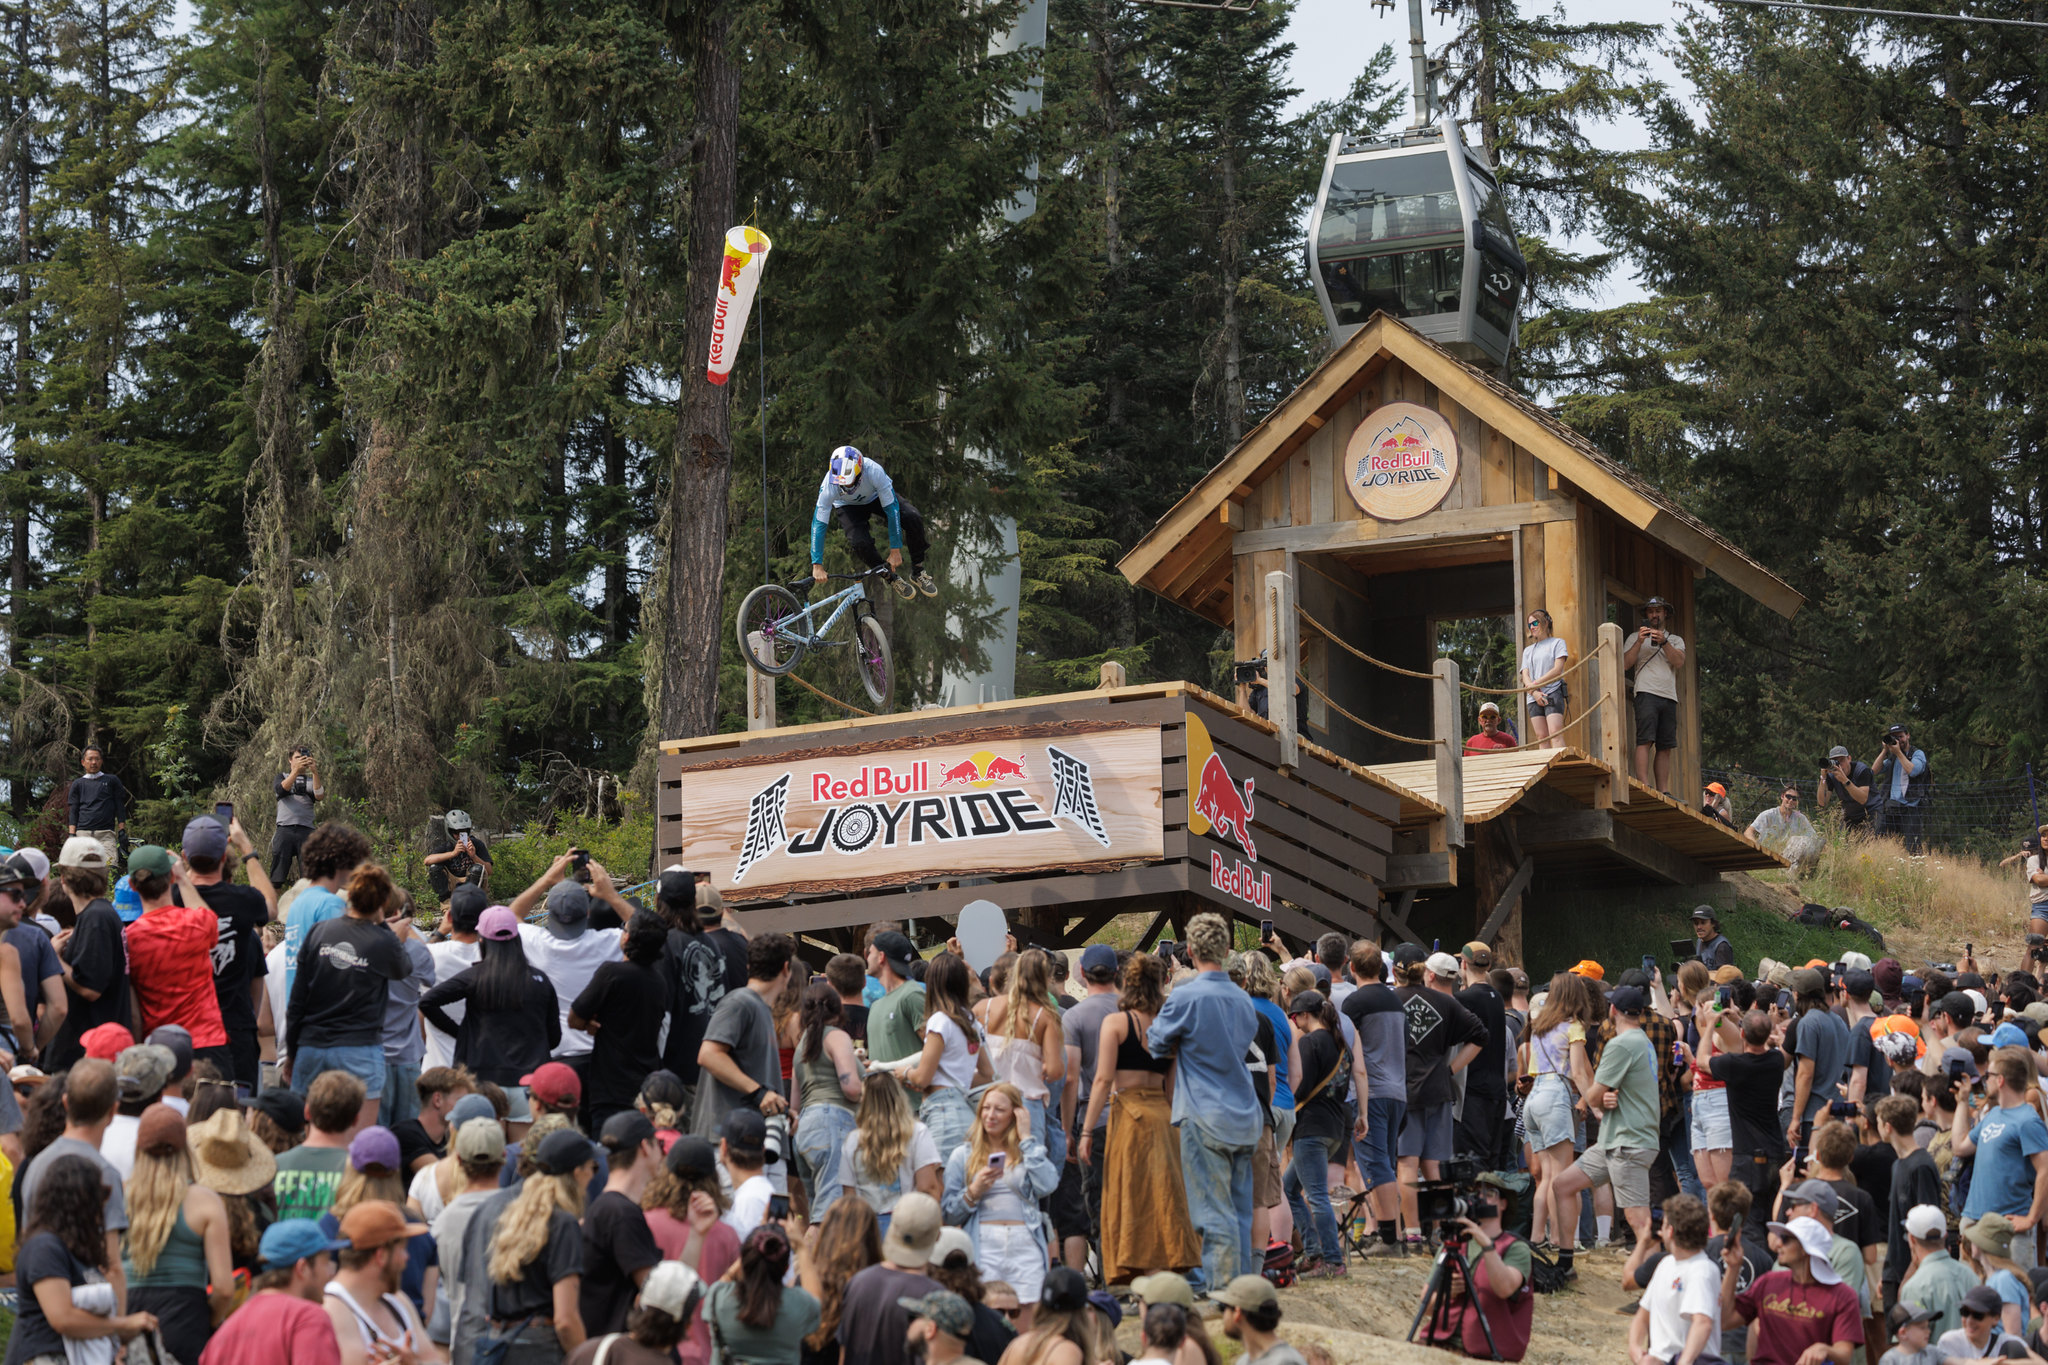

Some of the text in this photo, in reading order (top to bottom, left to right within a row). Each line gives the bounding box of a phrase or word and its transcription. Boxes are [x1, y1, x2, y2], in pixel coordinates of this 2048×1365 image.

[1361, 468, 1441, 487] JOYRIDE
[1371, 450, 1430, 470] Red Bull
[813, 761, 928, 801] Red Bull
[787, 789, 1056, 854] JOYRIDE
[1211, 851, 1270, 910] Red Bull
[1413, 1011, 1422, 1026] S
[274, 1170, 343, 1207] FERNI
